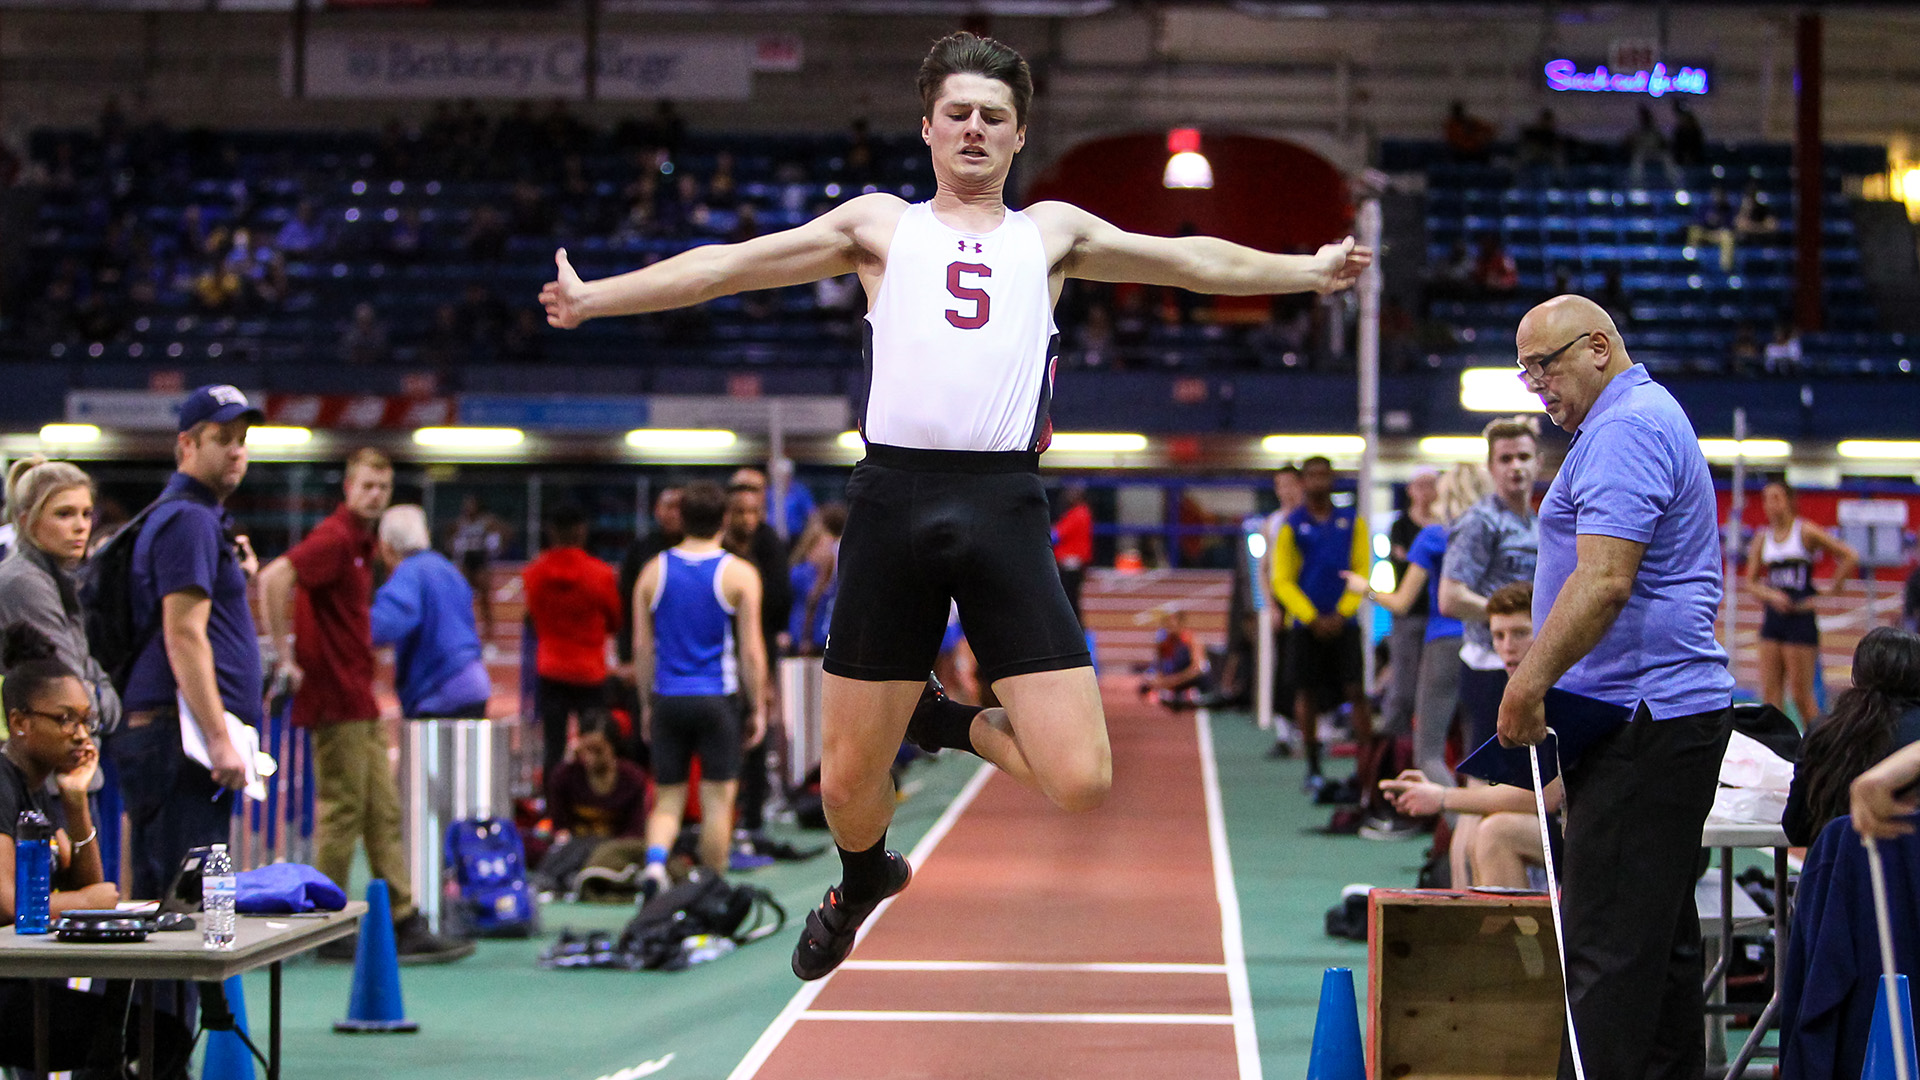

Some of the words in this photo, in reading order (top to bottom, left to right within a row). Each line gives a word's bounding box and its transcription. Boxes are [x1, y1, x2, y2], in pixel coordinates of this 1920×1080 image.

[387, 37, 534, 89] Berkeley
[545, 37, 679, 89] Cllege
[945, 261, 992, 330] S
